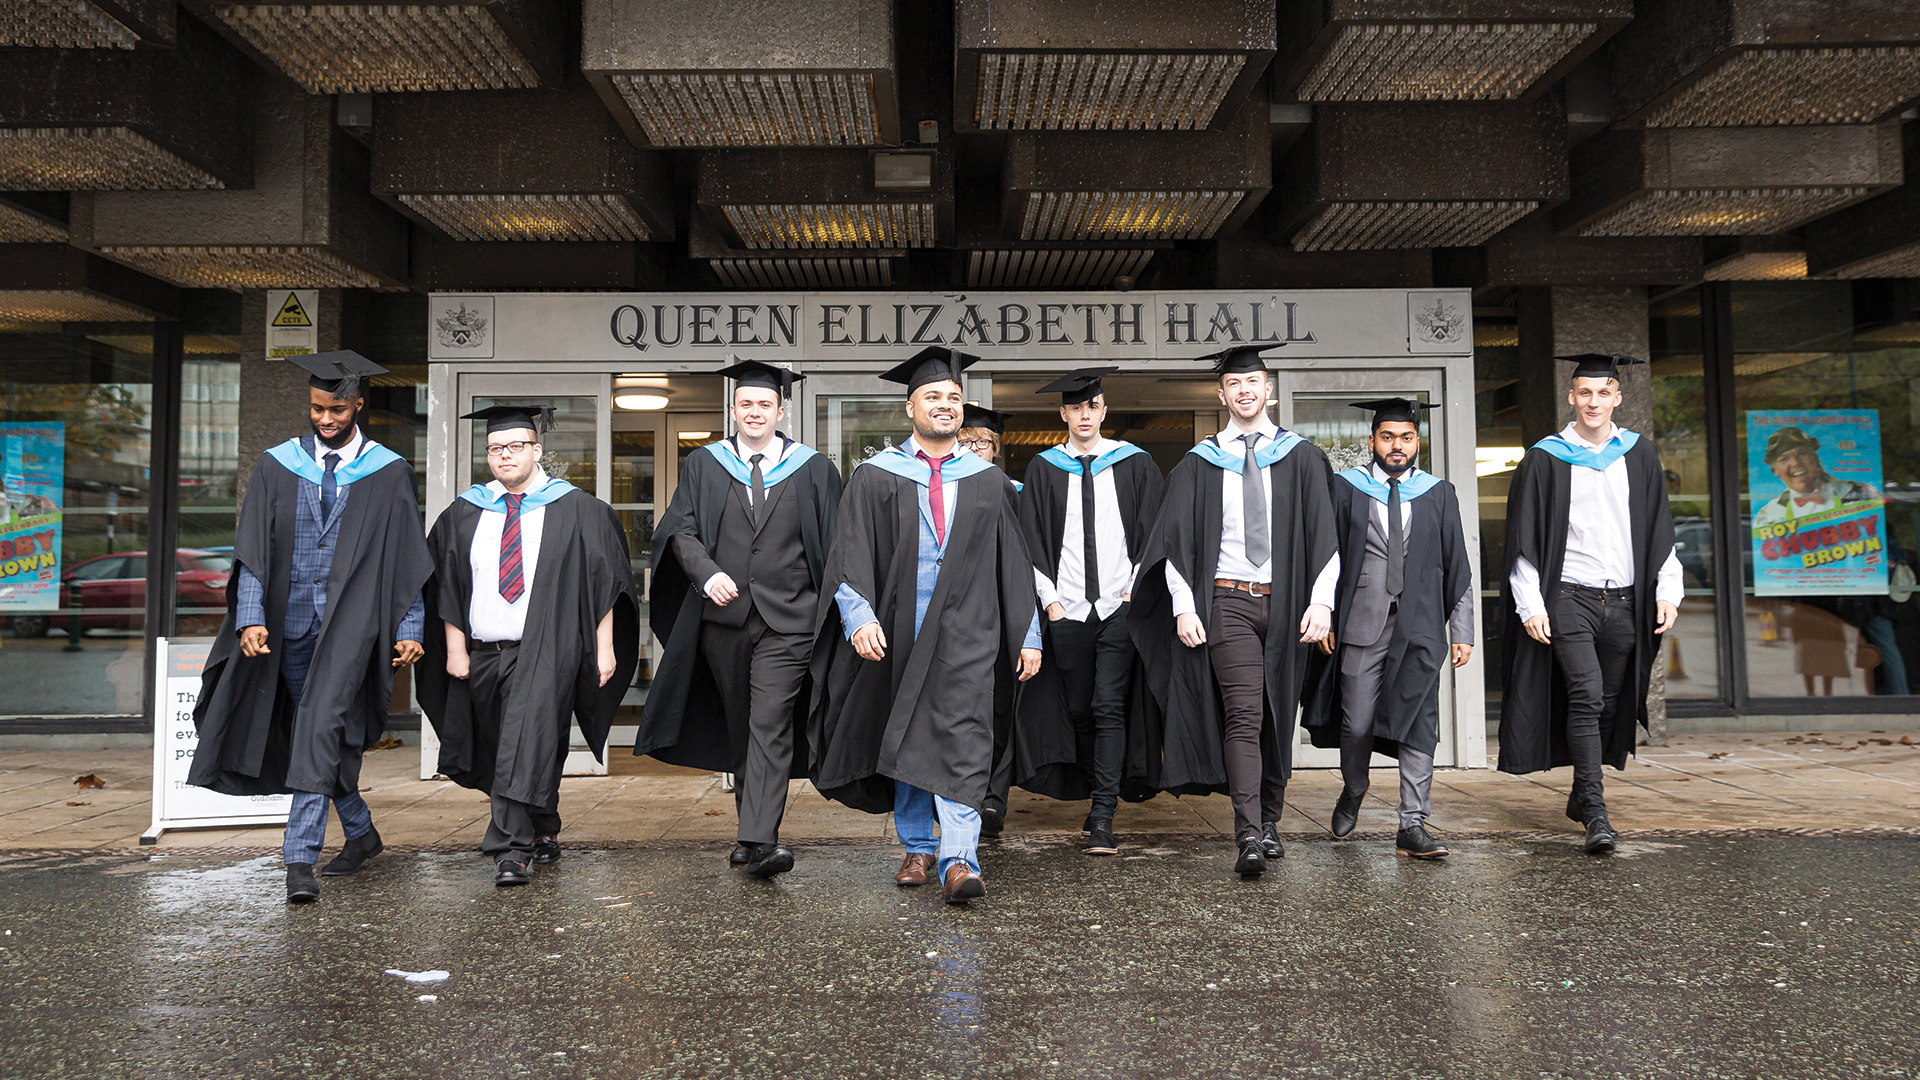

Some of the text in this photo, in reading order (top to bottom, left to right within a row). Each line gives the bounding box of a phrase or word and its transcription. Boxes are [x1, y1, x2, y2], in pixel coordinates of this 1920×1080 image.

[282, 316, 302, 324] CCTV
[610, 302, 1318, 352] QUEEN ELIZABETH HALL
[1759, 520, 1798, 541] ROY
[1761, 514, 1878, 559] CHUBBY
[1801, 537, 1883, 568] BROWN
